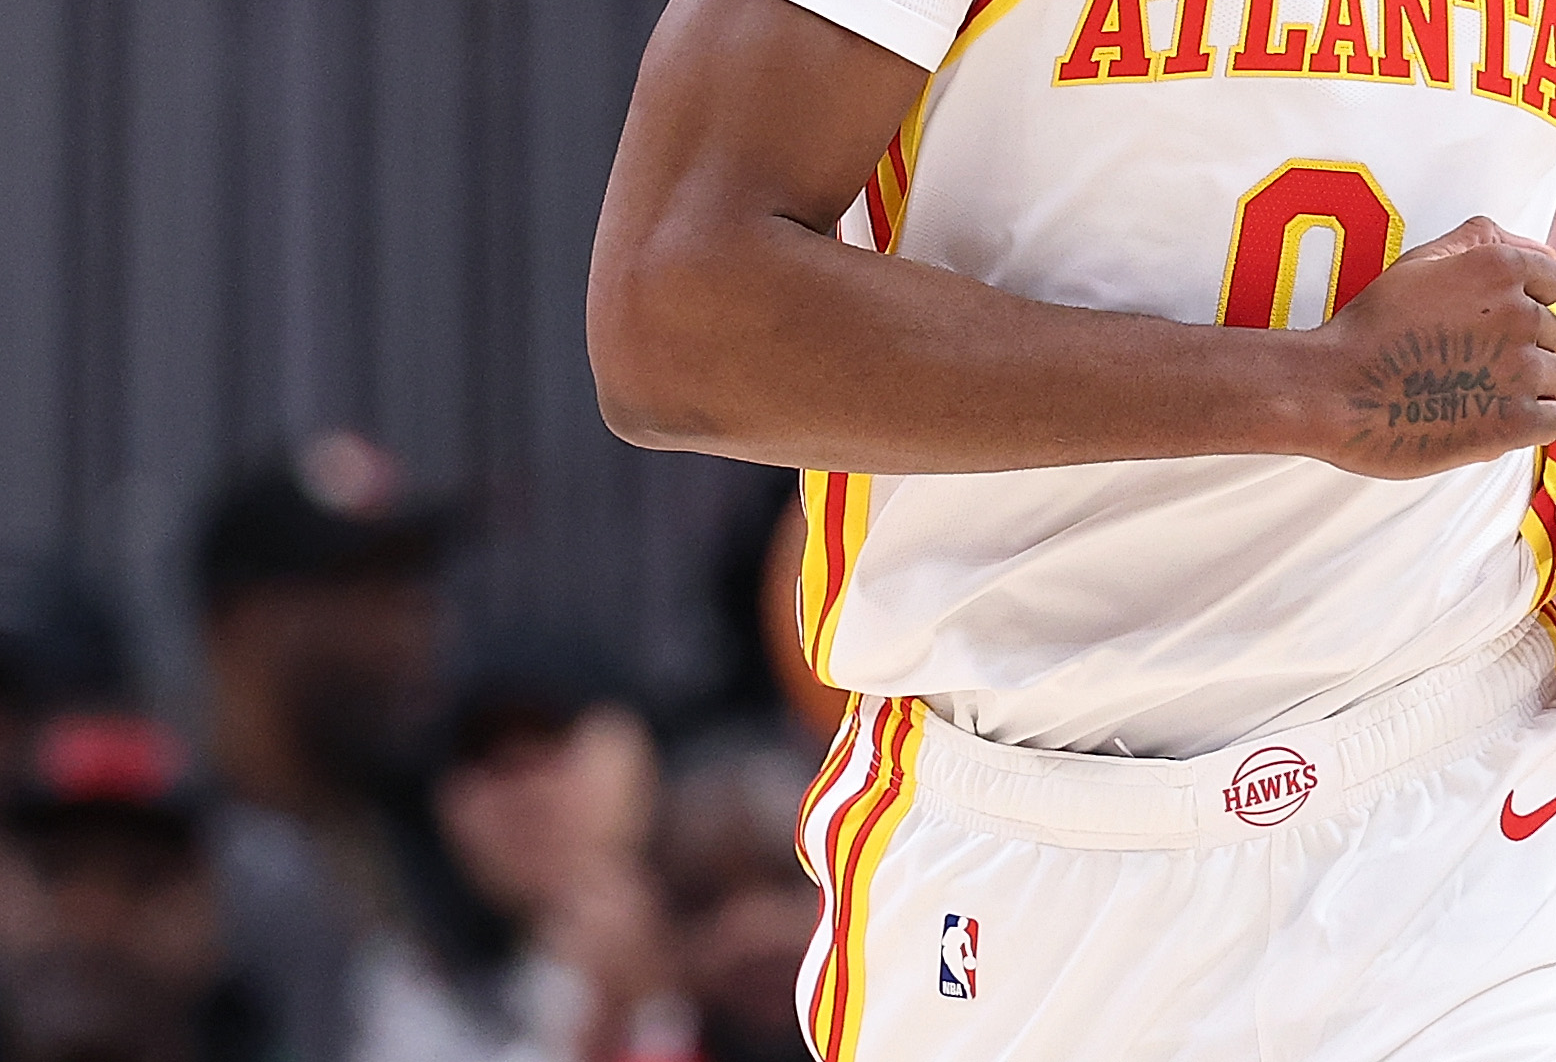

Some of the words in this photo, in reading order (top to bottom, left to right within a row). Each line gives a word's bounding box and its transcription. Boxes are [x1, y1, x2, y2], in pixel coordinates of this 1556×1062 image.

[1215, 157, 1405, 330] 0
[1222, 763, 1318, 812] HAWKS
[942, 980, 963, 997] NBA
